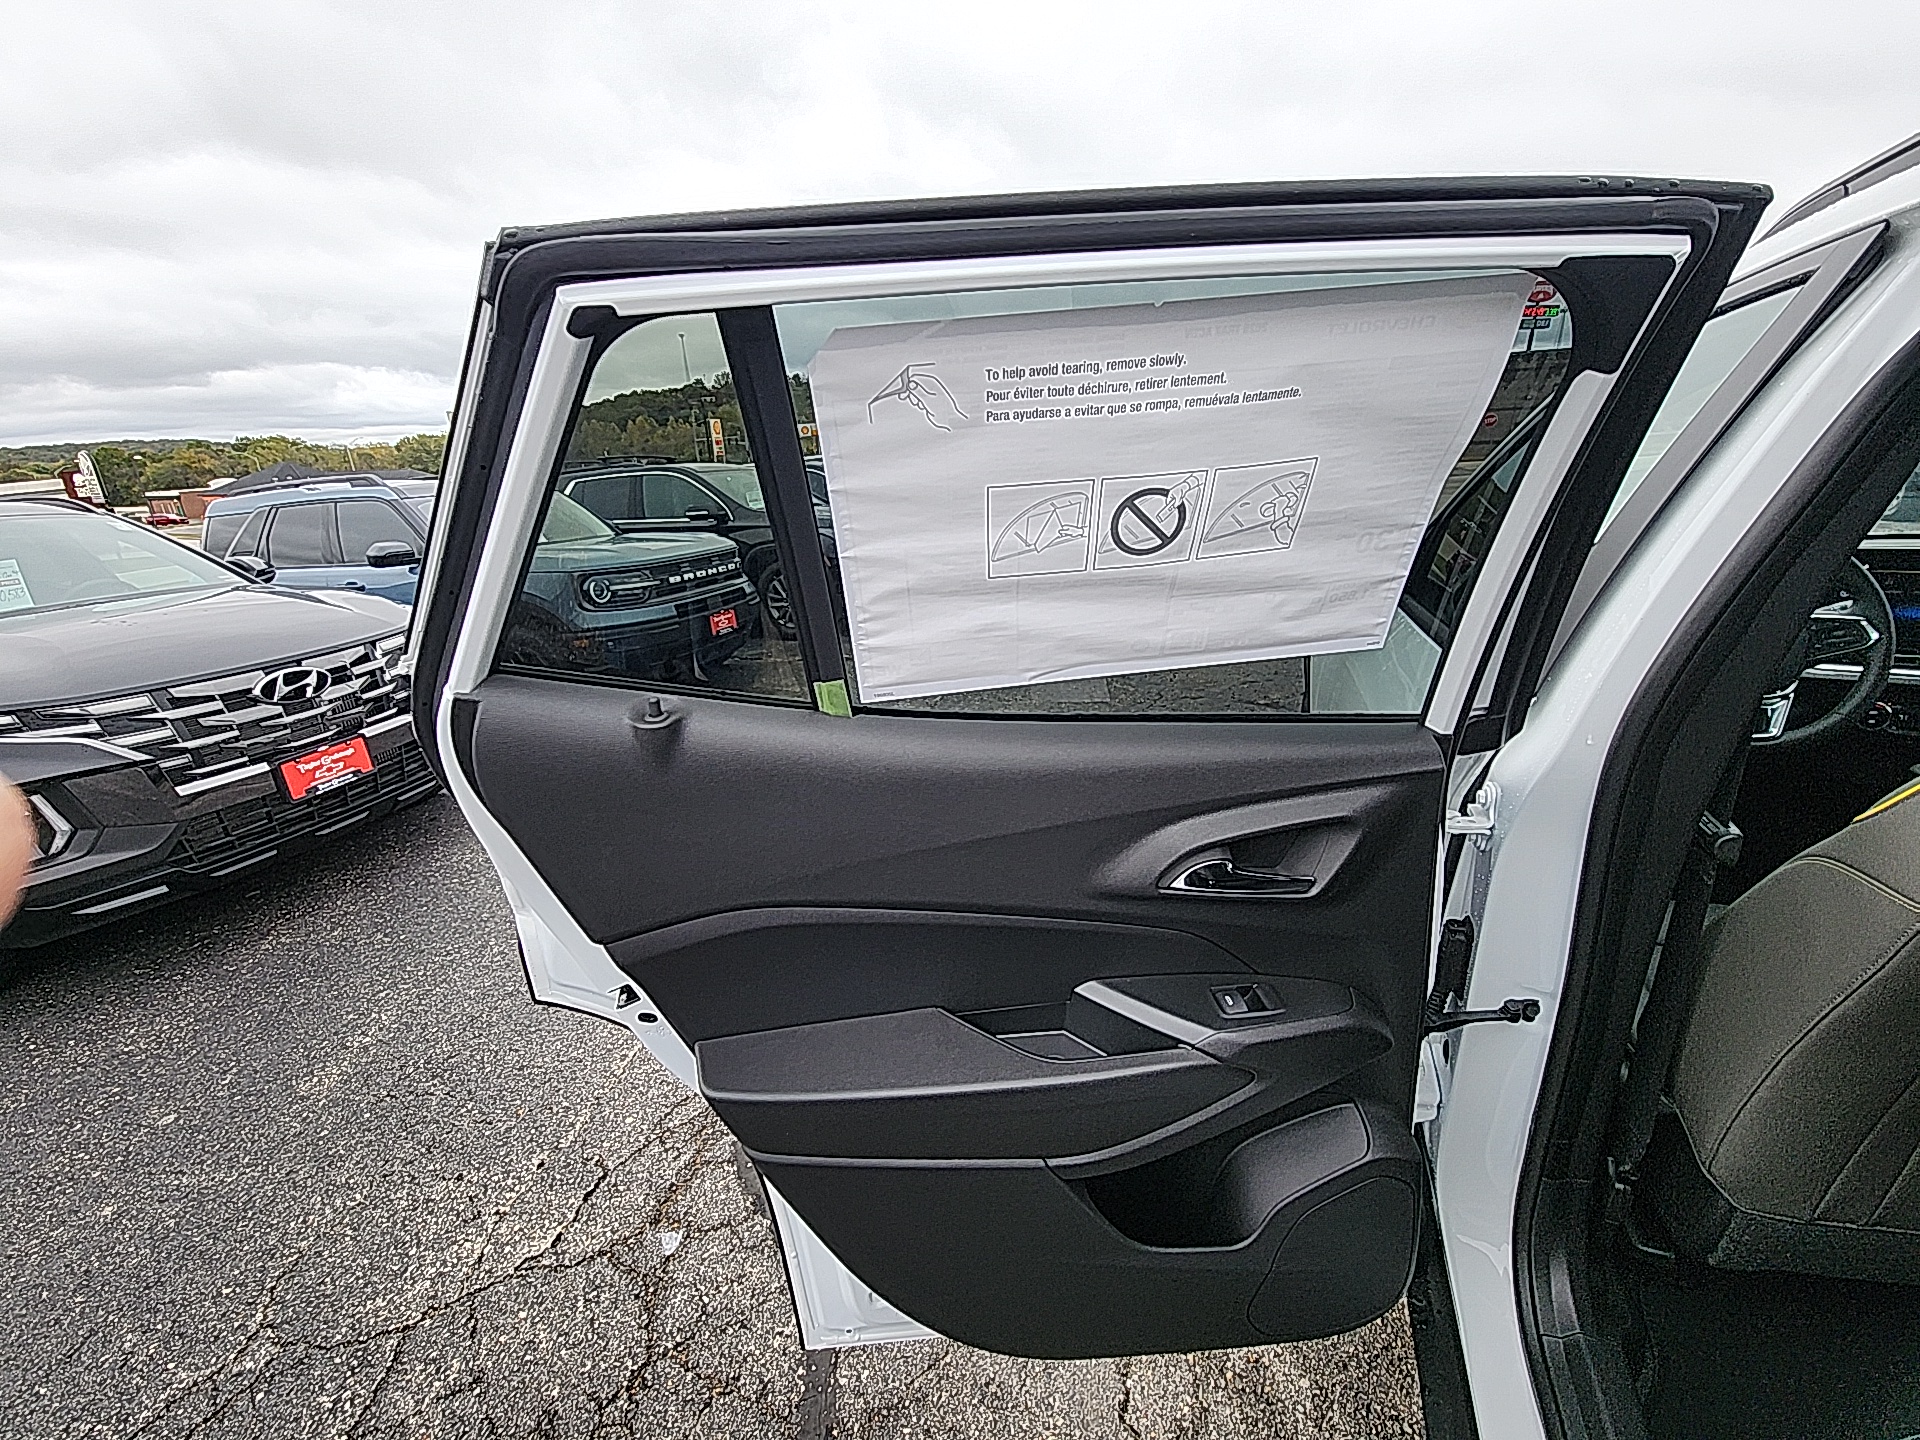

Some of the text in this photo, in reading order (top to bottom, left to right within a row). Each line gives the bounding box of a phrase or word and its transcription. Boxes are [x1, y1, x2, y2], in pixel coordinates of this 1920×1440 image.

[985, 352, 1187, 382] To help avoid tearing, remove slowly.
[986, 371, 1227, 403] Pour éviter toute déchirure, retirer lentement.
[986, 386, 1302, 423] Para ayudarse a evitar que se rompa, remuévala lentamente.
[1484, 416, 1498, 424] STOP
[668, 563, 736, 584] BRONCO
